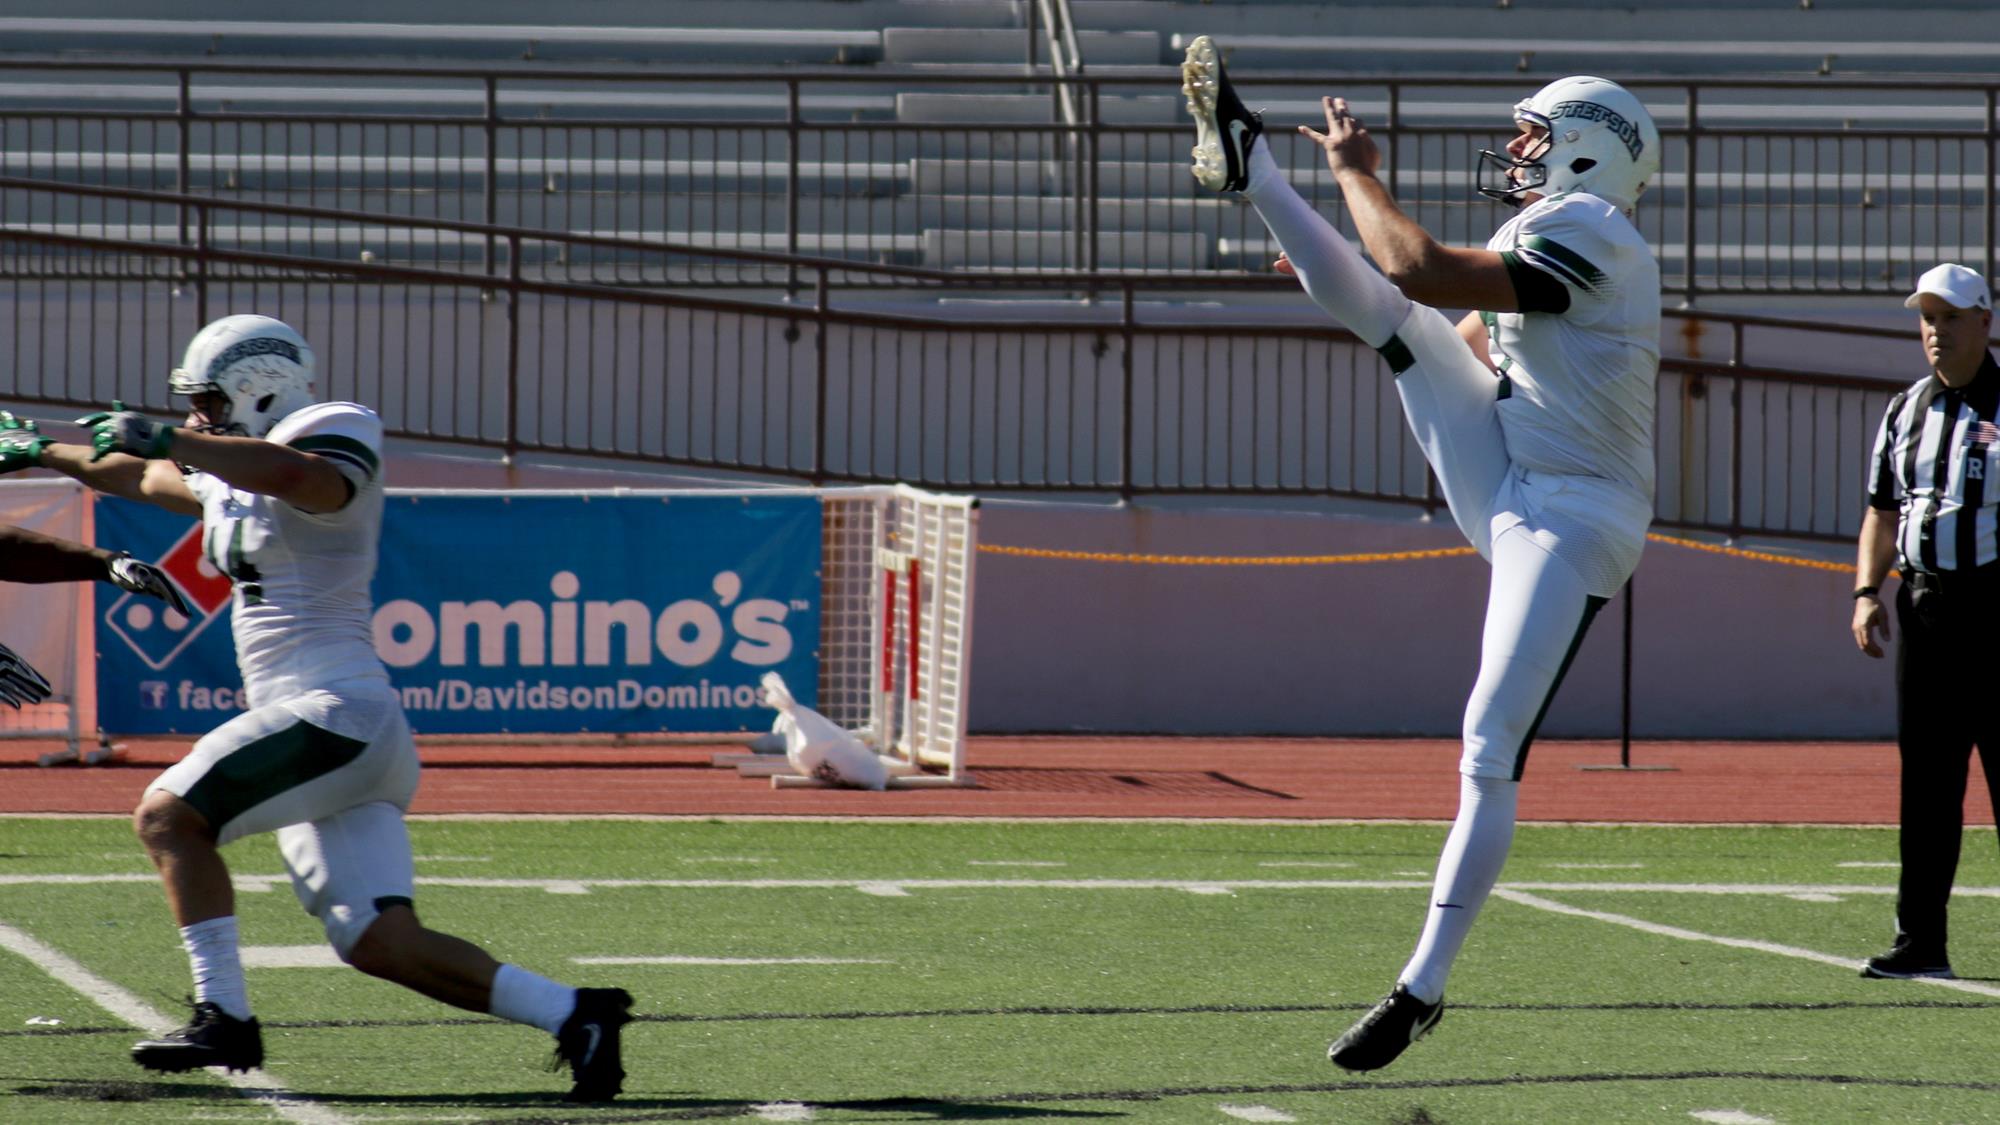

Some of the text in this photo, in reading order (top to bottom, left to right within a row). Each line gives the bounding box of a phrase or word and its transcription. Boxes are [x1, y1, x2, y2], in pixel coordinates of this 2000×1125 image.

[1549, 100, 1644, 163] STETSON
[1967, 456, 1984, 480] R
[371, 571, 793, 667] omino's
